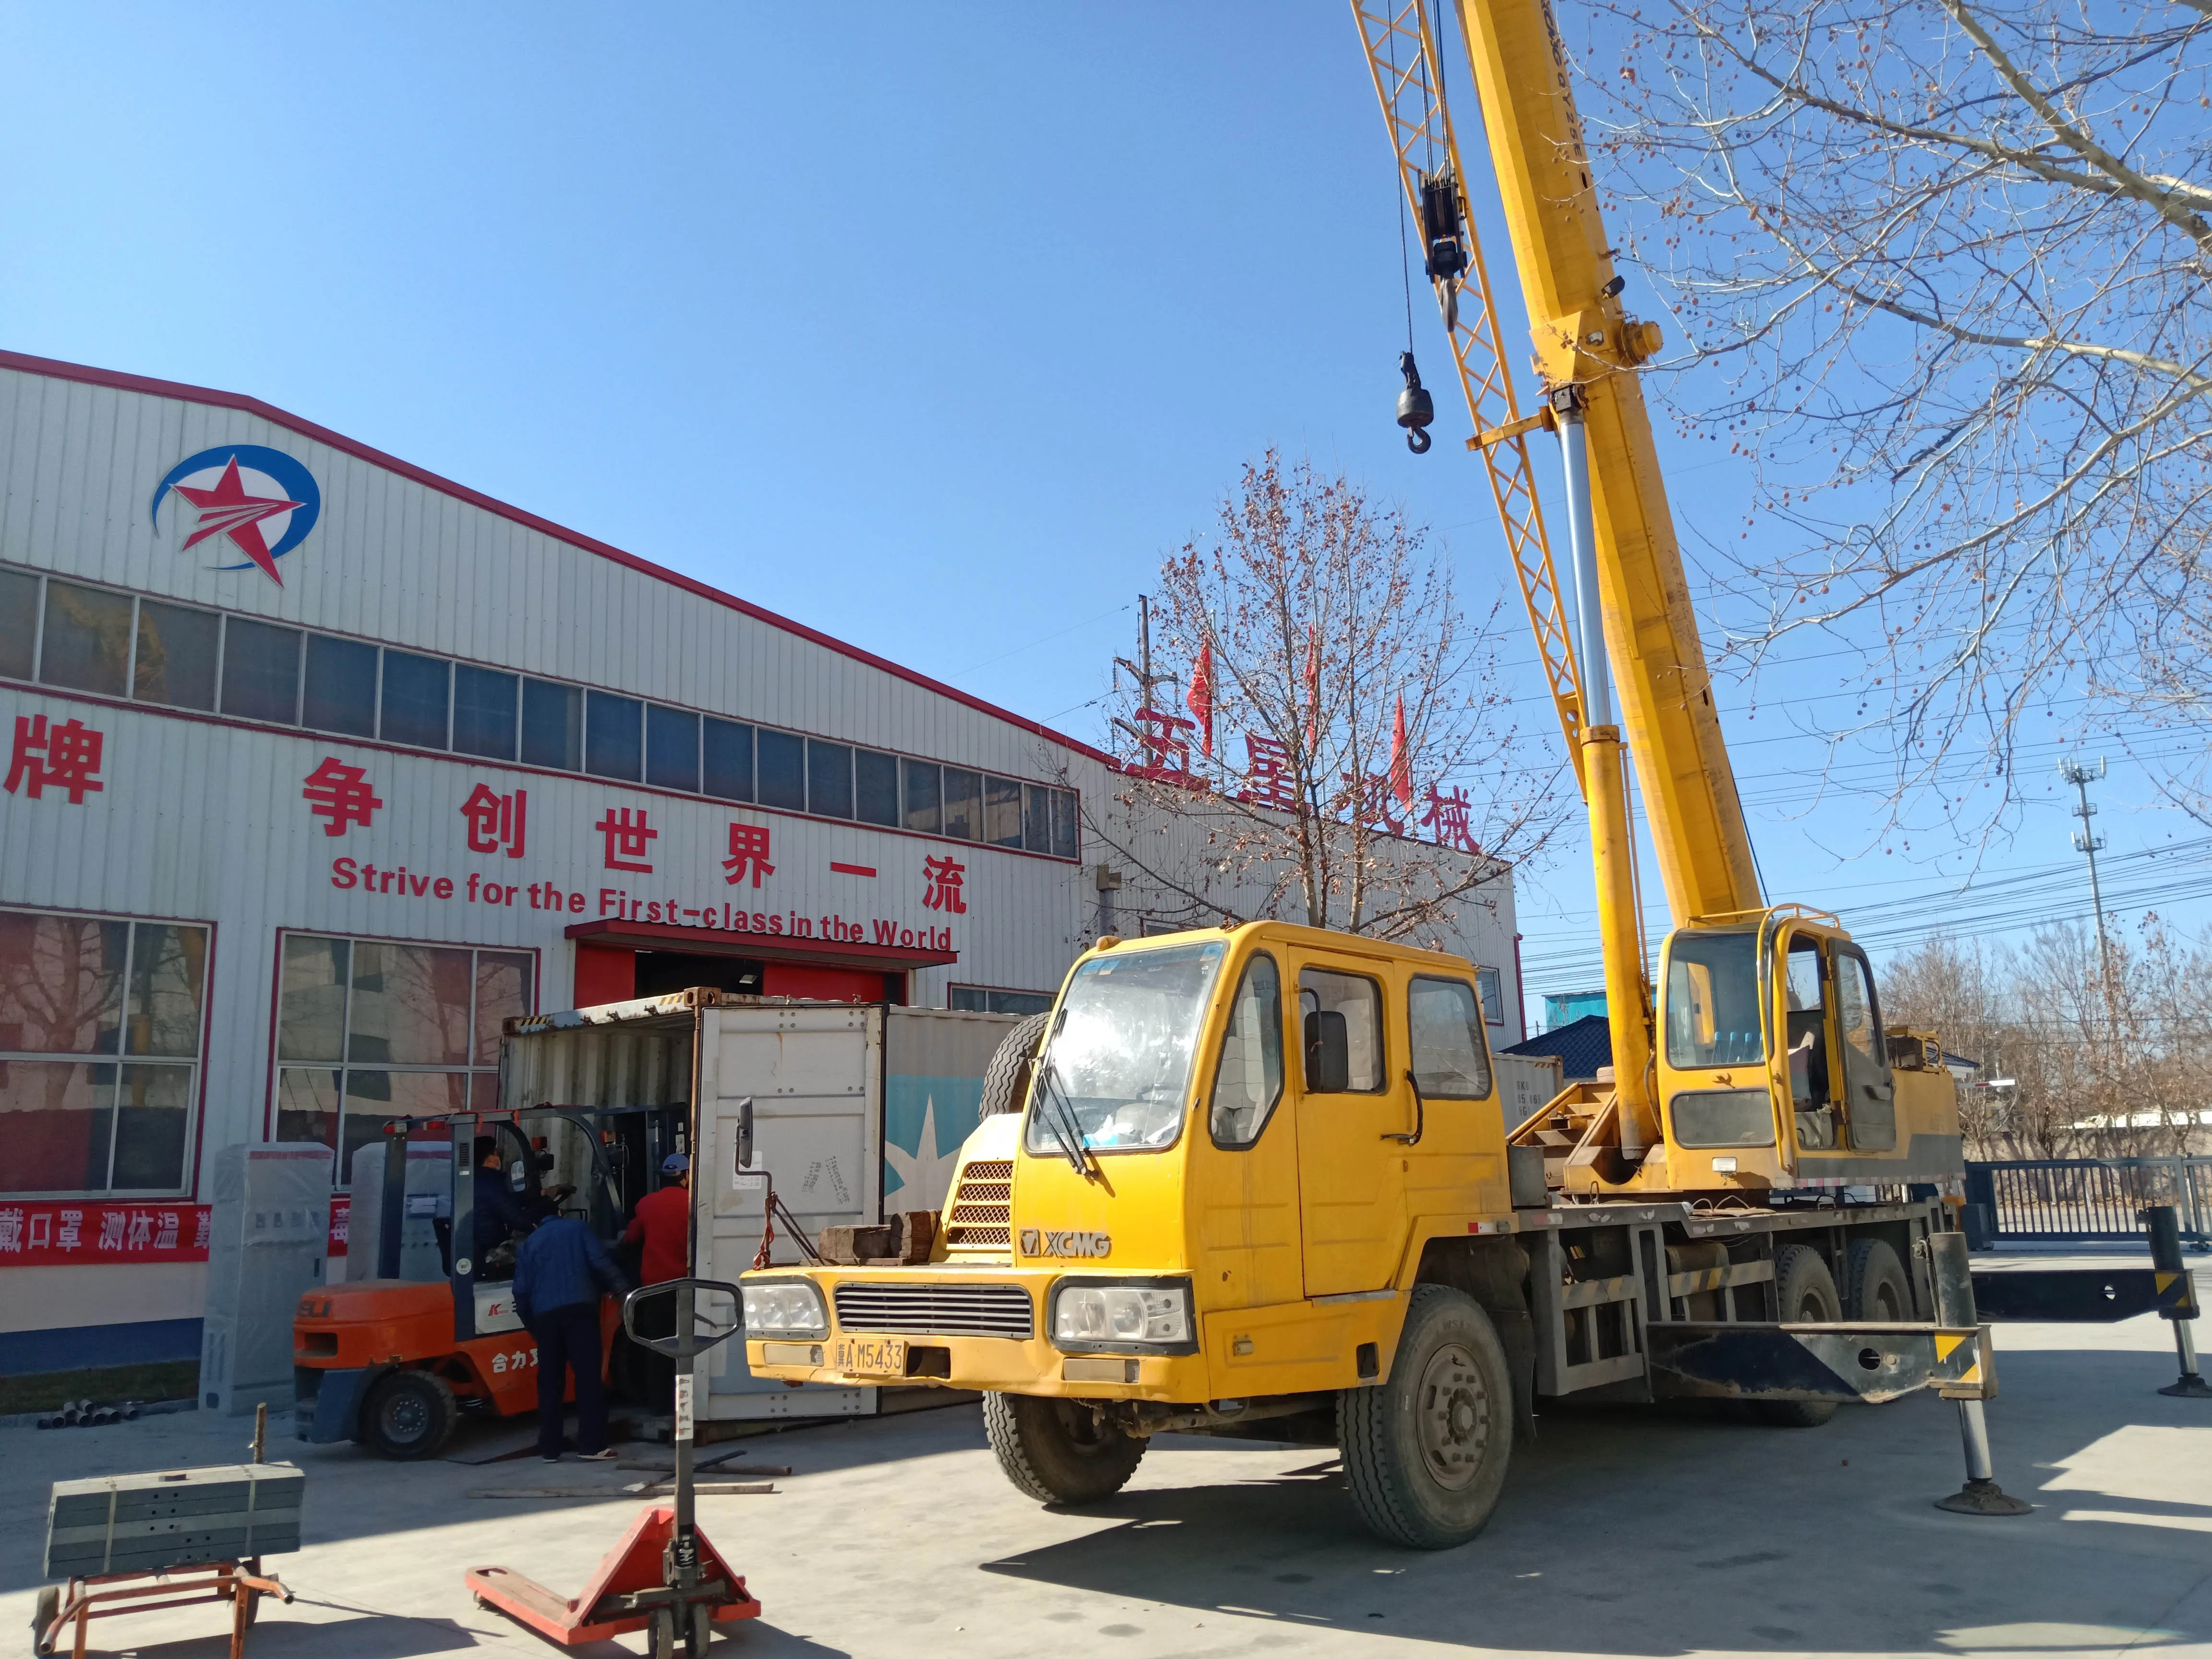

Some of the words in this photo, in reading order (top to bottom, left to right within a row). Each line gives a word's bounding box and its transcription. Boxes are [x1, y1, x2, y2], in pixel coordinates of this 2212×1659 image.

[4, 714, 104, 804] 牌
[303, 757, 967, 914] 争创世界一流
[331, 857, 454, 900] Strive
[467, 873, 518, 906] for
[528, 881, 585, 914] the
[600, 888, 782, 935] First-class
[790, 910, 812, 937] in
[819, 914, 864, 942] the
[874, 919, 951, 951] World
[0, 1208, 83, 1253] 戴口罩
[98, 1210, 180, 1251] 测体温
[1043, 1231, 1112, 1259] XCMG
